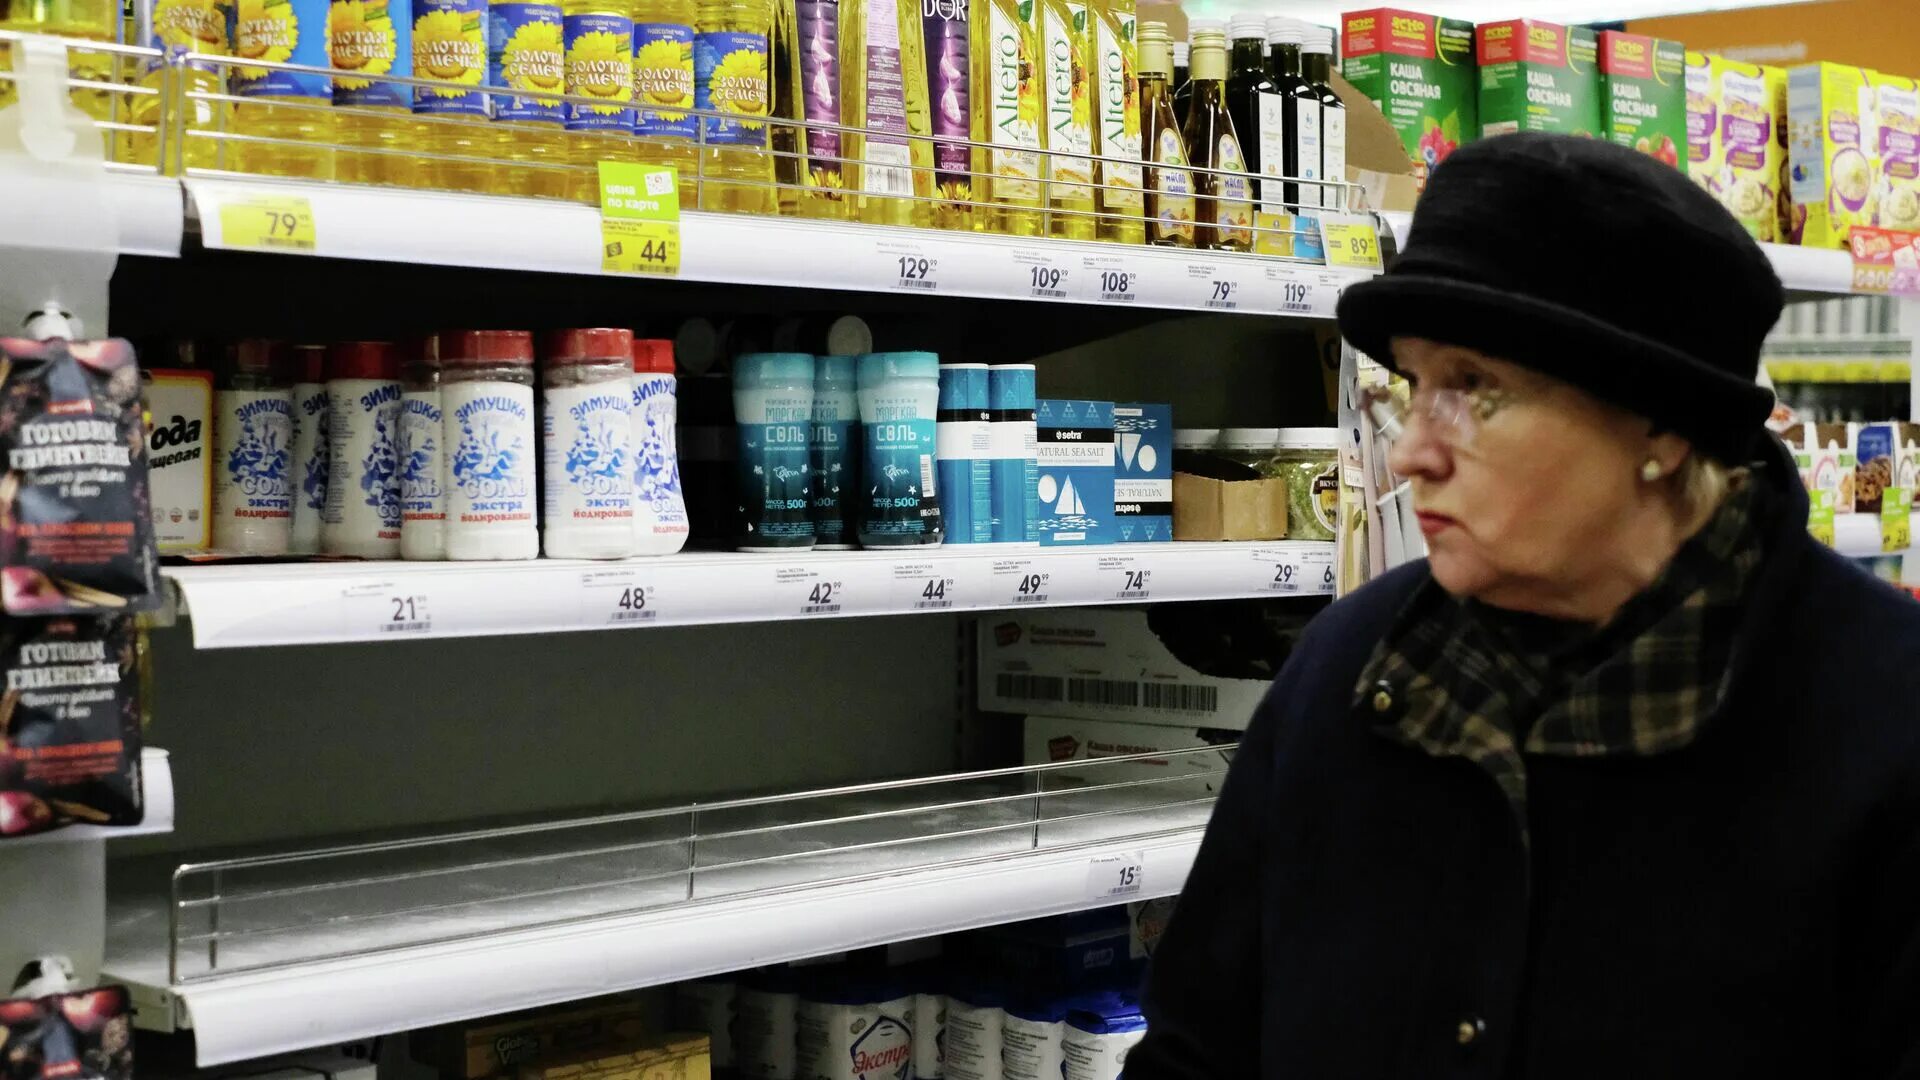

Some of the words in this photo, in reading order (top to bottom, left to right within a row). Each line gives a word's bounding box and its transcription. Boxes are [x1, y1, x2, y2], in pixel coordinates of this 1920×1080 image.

[1390, 62, 1423, 80] КАША
[1527, 69, 1555, 88] КАША
[996, 35, 1019, 140] Altero
[1051, 40, 1073, 143] Altero
[1390, 79, 1442, 100] ОВСЯНАЯ
[1527, 86, 1572, 108] ОВСЯНАЯ
[1613, 82, 1642, 99] КАША
[1105, 52, 1126, 152] Altero
[1613, 98, 1658, 118] ОВСЯНАЯ
[605, 184, 636, 196] цена
[607, 197, 623, 208] по
[625, 199, 660, 212] карте
[265, 211, 297, 236] 79
[641, 239, 667, 263] 44
[1350, 237, 1369, 255] 89
[898, 256, 929, 280] 129
[930, 259, 938, 267] 99
[1031, 266, 1061, 289] 109
[1101, 271, 1128, 293] 108
[1213, 281, 1230, 300] 79
[1284, 282, 1306, 303] 119
[453, 396, 527, 424] ЗИМУШКА
[20, 419, 118, 446] ГОТОВИМ
[150, 414, 202, 450] ода
[765, 426, 805, 443] СОЛЬ
[876, 424, 917, 442] СОЛЬ
[1062, 431, 1082, 440] setra
[1038, 447, 1070, 457] ATURAL
[1072, 447, 1086, 457] SEA
[1088, 447, 1105, 457] SALT
[894, 497, 920, 508] 500г
[1127, 488, 1162, 497] NATURAL
[471, 500, 523, 512] экстра
[787, 498, 807, 510] 500г
[1125, 570, 1143, 590] 74
[1274, 564, 1293, 582] 29
[1324, 565, 1336, 583] 6
[809, 582, 832, 604] 42
[922, 579, 945, 600] 44
[946, 578, 954, 586] 99
[1019, 574, 1041, 594] 49
[619, 588, 646, 610] 48
[391, 597, 415, 622] 21
[20, 640, 106, 665] ГОТОВИМ
[1087, 739, 1114, 752] Каша
[1119, 866, 1135, 886] 15
